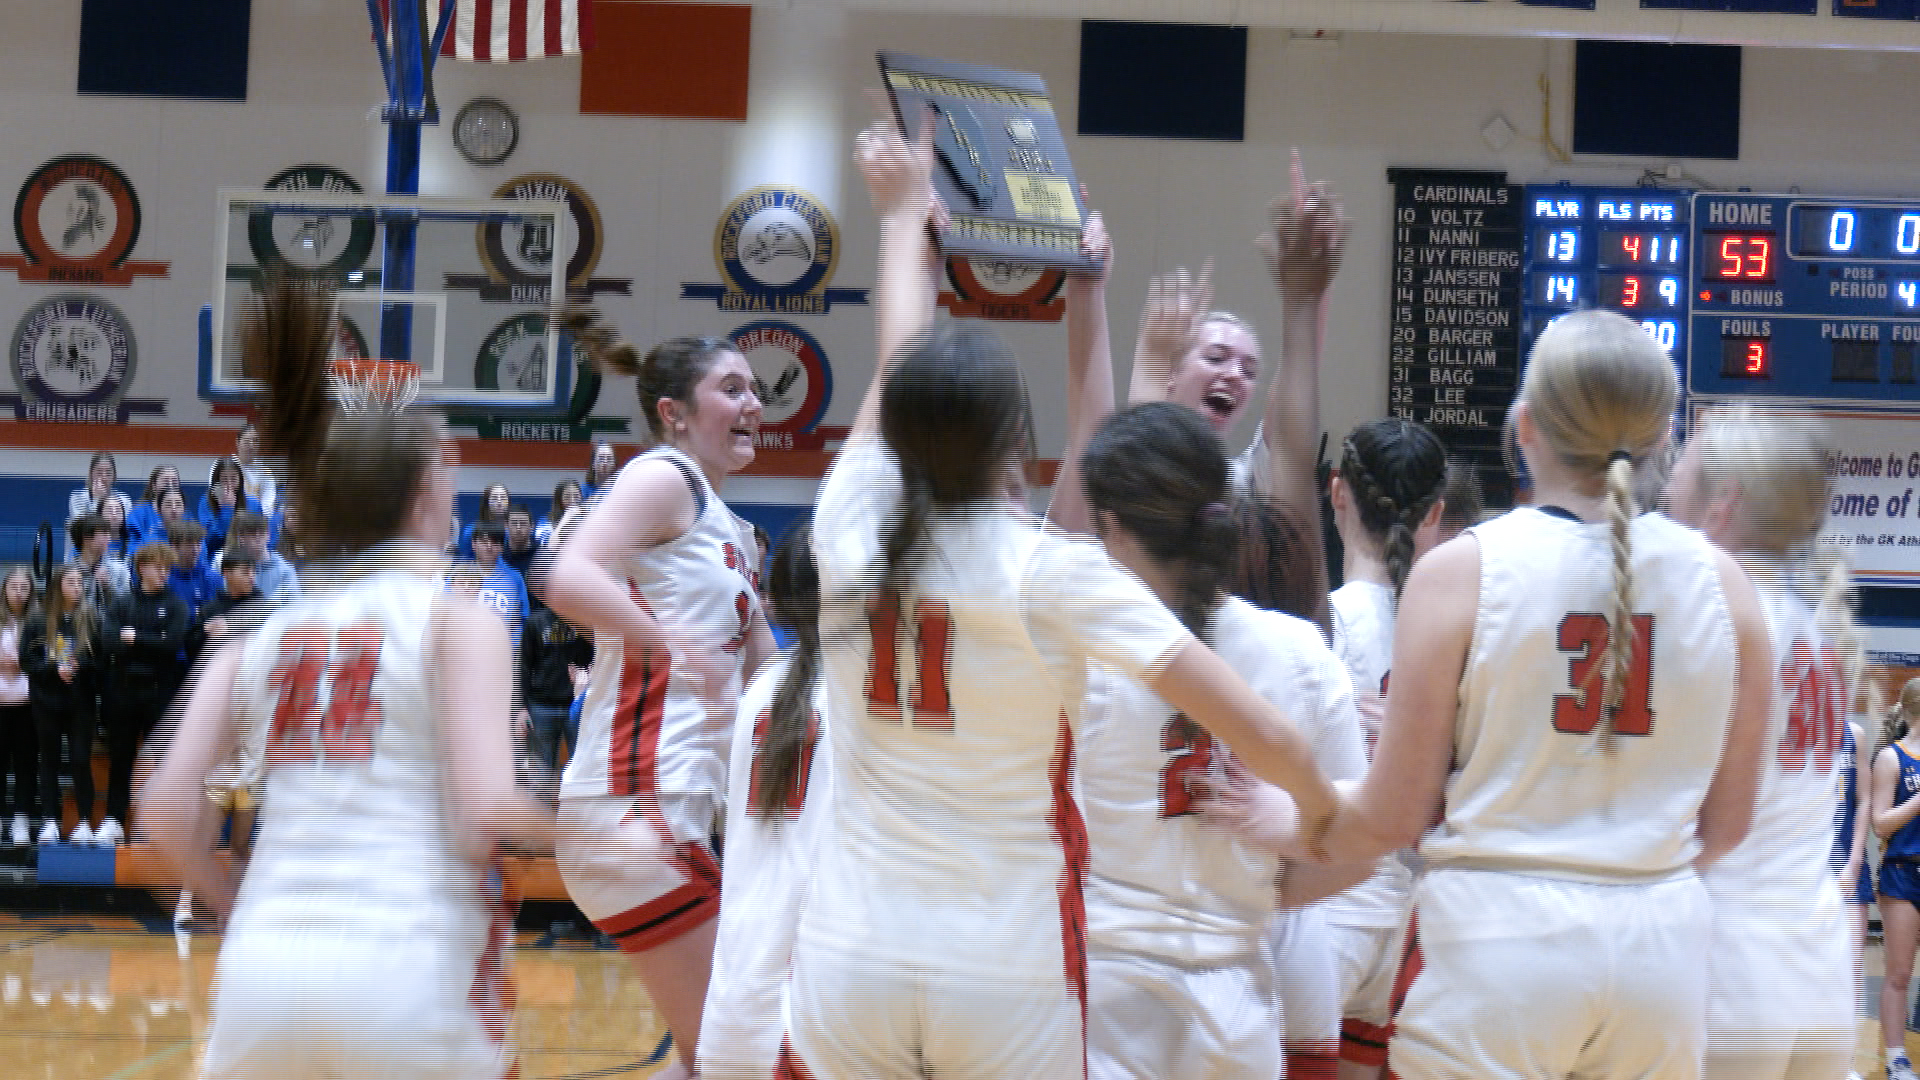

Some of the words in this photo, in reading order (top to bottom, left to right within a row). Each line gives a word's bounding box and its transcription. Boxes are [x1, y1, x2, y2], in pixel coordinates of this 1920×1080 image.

[514, 181, 568, 202] DIXON
[1413, 185, 1508, 205] CARDINALS
[1398, 207, 1415, 225] 10
[1431, 208, 1484, 226] VOLTZ
[1536, 199, 1579, 218] PLYR
[1599, 201, 1632, 220] FLS
[1640, 203, 1673, 222] PTS
[1709, 202, 1773, 225] HOME
[957, 217, 1082, 252] HAMPION
[1398, 227, 1410, 244] 11
[1429, 229, 1480, 246] NANNI
[1829, 211, 1855, 252] 0
[1896, 214, 1920, 253] 0
[1548, 230, 1576, 262] 13
[1623, 235, 1640, 262] 4
[1650, 236, 1678, 263] 11
[1720, 236, 1769, 277] 53
[1398, 247, 1415, 264] 12
[1420, 248, 1447, 265] IVY
[1450, 248, 1520, 268] FRIBERG
[1397, 267, 1413, 284] 13
[1423, 268, 1500, 287] JANSSEN
[1843, 267, 1874, 280] POSS
[511, 284, 552, 303] DUKE
[1397, 287, 1413, 303] 14
[1423, 287, 1499, 307] DUNSETH
[1546, 275, 1576, 303] 14
[1621, 275, 1639, 307] 3
[1659, 277, 1677, 307] 9
[1731, 289, 1784, 306] BONUS
[1830, 281, 1888, 299] PERIOD
[1898, 281, 1917, 308] 4
[722, 291, 771, 312] ROYAL
[775, 294, 825, 315] LIONS
[1396, 306, 1412, 322] 15
[1425, 307, 1509, 327] DAVIDSON
[1393, 327, 1415, 343] 20
[1429, 328, 1494, 346] BARGER
[1721, 319, 1771, 336] FOULS
[1821, 323, 1880, 340] PLAYER
[737, 328, 806, 355] OREGON
[1393, 347, 1414, 363] 22
[1428, 347, 1497, 366] GILLIAM
[1746, 344, 1764, 372] 3
[1393, 367, 1409, 383] 31
[1430, 368, 1474, 385] BAGG
[1392, 387, 1413, 403] 32
[1435, 387, 1465, 405] LEE
[26, 402, 118, 425] CRUSADERS
[1423, 407, 1488, 427] JORDAL
[501, 422, 571, 441] ROCKETS
[753, 431, 794, 450] AWKS
[1825, 449, 1883, 477] elcome
[1887, 452, 1903, 479] to
[1907, 451, 1920, 479] G
[1830, 494, 1880, 517] ome
[1886, 487, 1913, 518] of
[1877, 534, 1896, 546] GK
[863, 590, 956, 734] 11
[1551, 612, 1656, 736] 31
[264, 619, 385, 769] 22
[1774, 634, 1848, 776] 30
